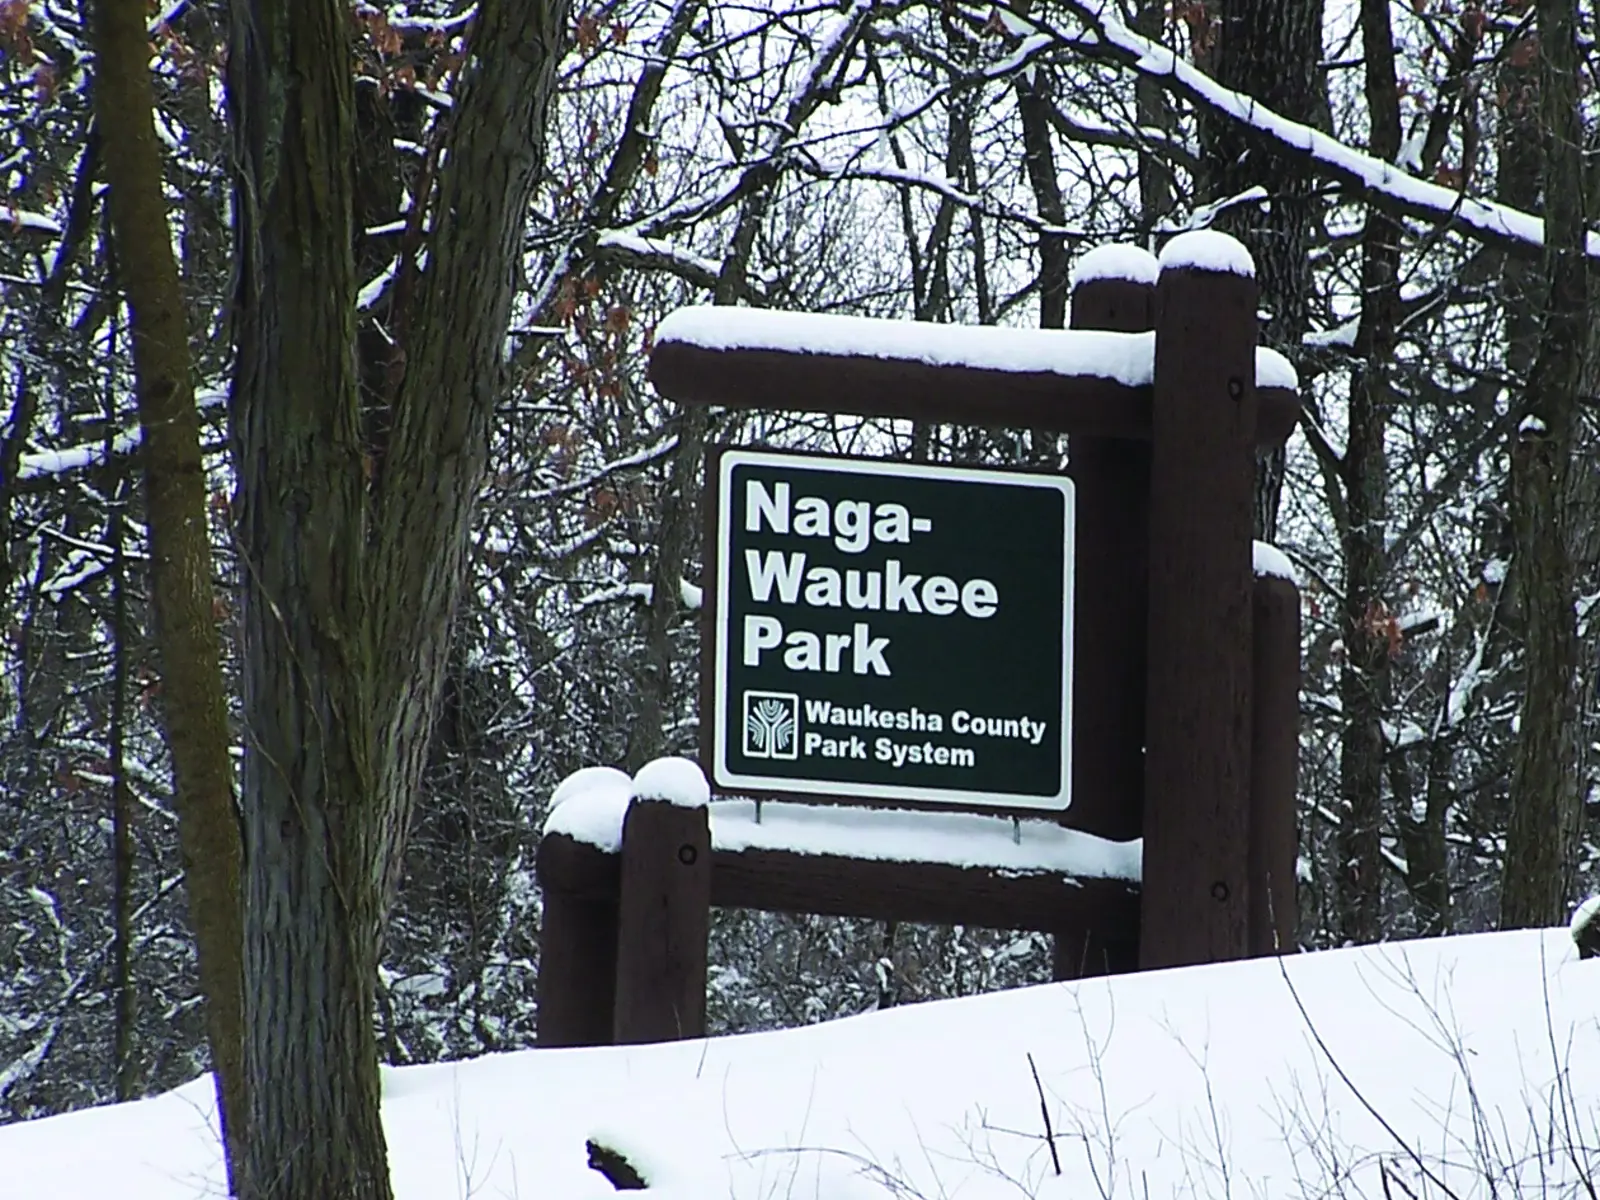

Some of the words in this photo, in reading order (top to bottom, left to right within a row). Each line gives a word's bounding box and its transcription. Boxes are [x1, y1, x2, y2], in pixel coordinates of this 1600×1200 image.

[745, 479, 932, 553] Naga-
[744, 548, 999, 618] Waukee
[743, 614, 892, 677] Park
[804, 699, 943, 732] Waukesha
[951, 710, 1047, 745] County
[804, 731, 867, 760] Park
[874, 737, 975, 768] System
